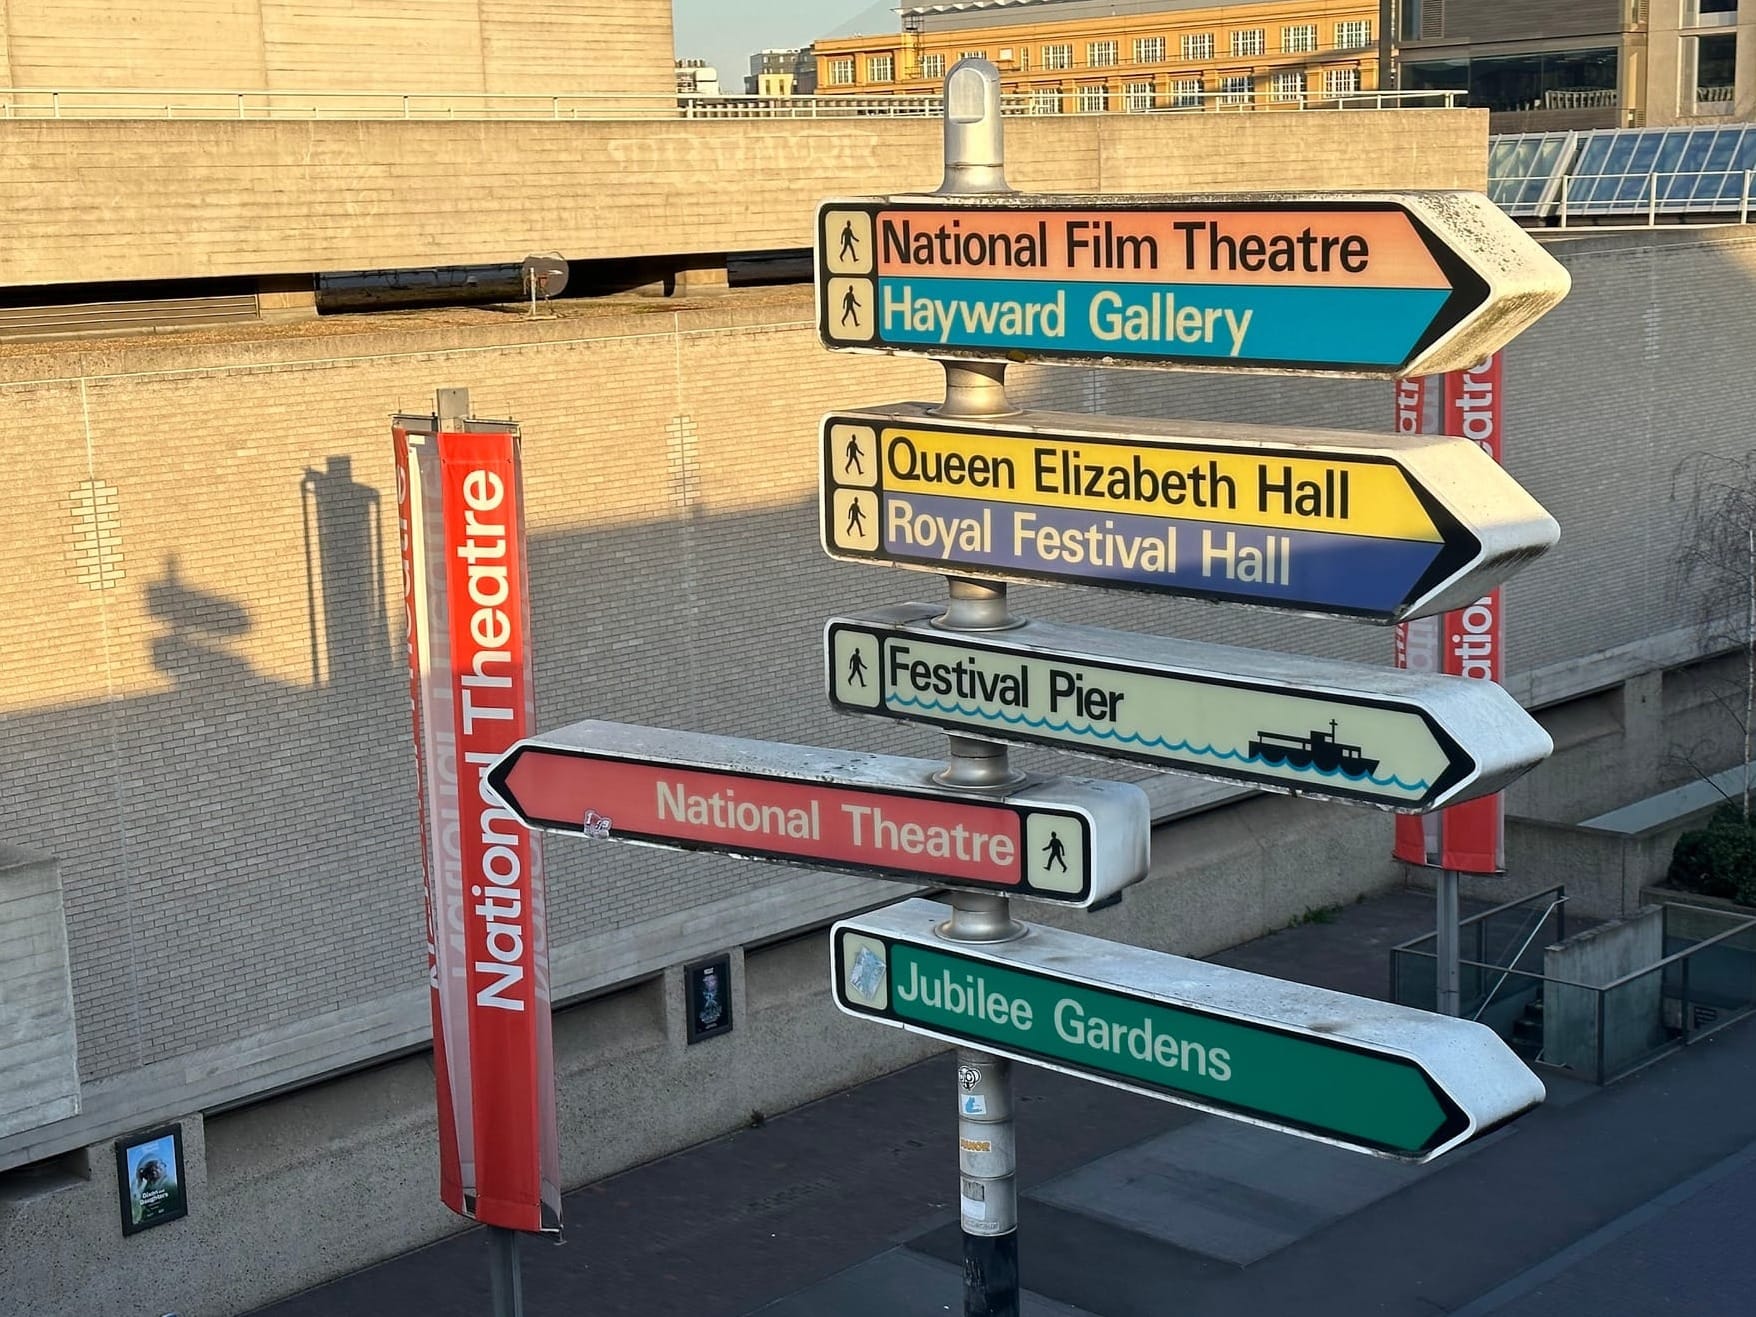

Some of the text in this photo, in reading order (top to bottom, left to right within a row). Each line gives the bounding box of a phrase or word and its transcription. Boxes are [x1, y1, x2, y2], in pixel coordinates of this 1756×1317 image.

[882, 219, 1369, 272] National Film Theatre
[882, 286, 1253, 356] Hayward Gallery
[887, 436, 1349, 519] Queen Elizabeth Hall
[888, 499, 1290, 585] Royal Festival Hall
[457, 470, 513, 735] Theatre
[889, 647, 1123, 722] Festival Pier
[657, 781, 820, 840] National
[842, 803, 1014, 865] Theatre
[897, 962, 1232, 1082] Jubilee Gardens
